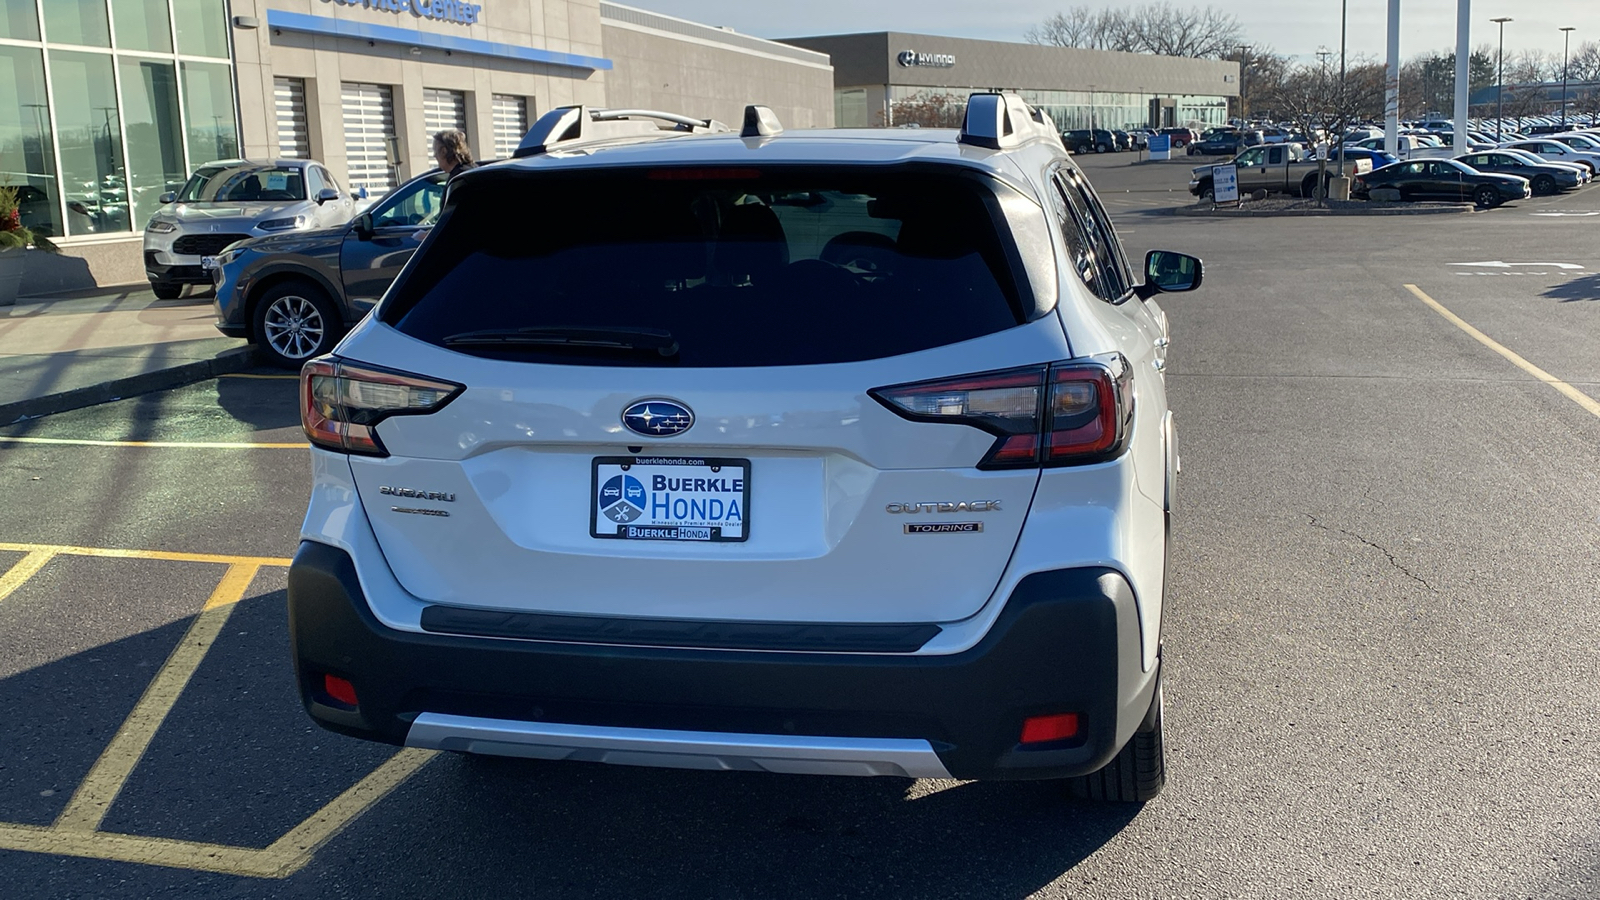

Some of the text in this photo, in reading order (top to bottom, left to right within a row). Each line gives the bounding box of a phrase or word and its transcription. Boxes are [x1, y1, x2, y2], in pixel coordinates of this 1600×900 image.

[410, 0, 482, 26] Center
[635, 457, 705, 466] buerklehonda.com
[652, 474, 744, 493] BUERKLE
[379, 485, 456, 502] SUBARU
[651, 492, 742, 521] HONDA
[886, 500, 1003, 514] OUTBACK
[628, 527, 709, 539] BUERKLE HONDA
[913, 524, 974, 532] TOURING
